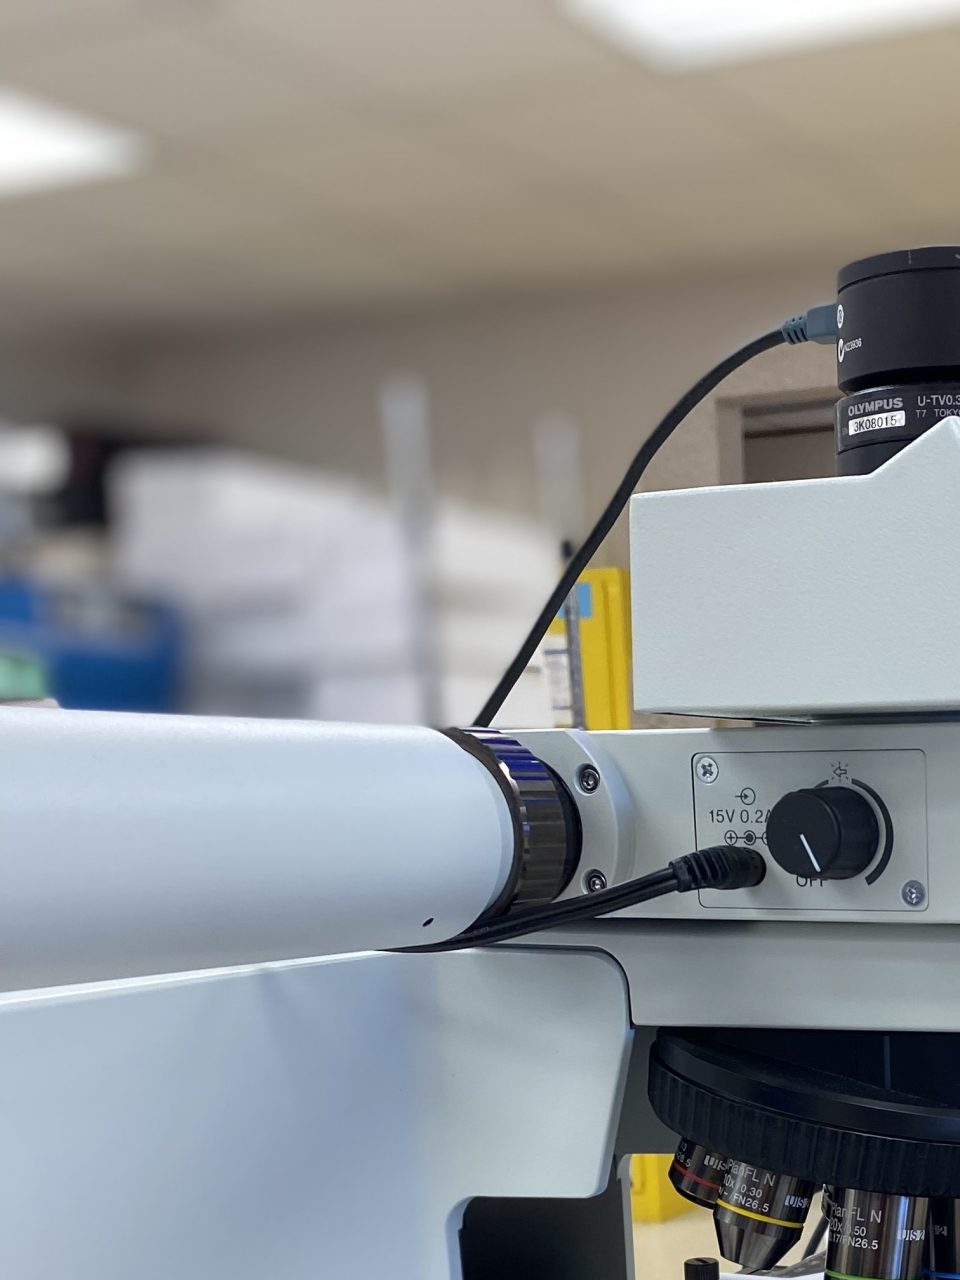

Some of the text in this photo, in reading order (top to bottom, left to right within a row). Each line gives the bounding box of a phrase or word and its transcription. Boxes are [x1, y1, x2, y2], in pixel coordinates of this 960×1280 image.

[848, 398, 903, 416] OLYMPUS
[854, 415, 897, 432] 3K08015
[709, 809, 735, 823] 15V
[763, 1173, 776, 1187] N
[870, 1209, 882, 1223] N
